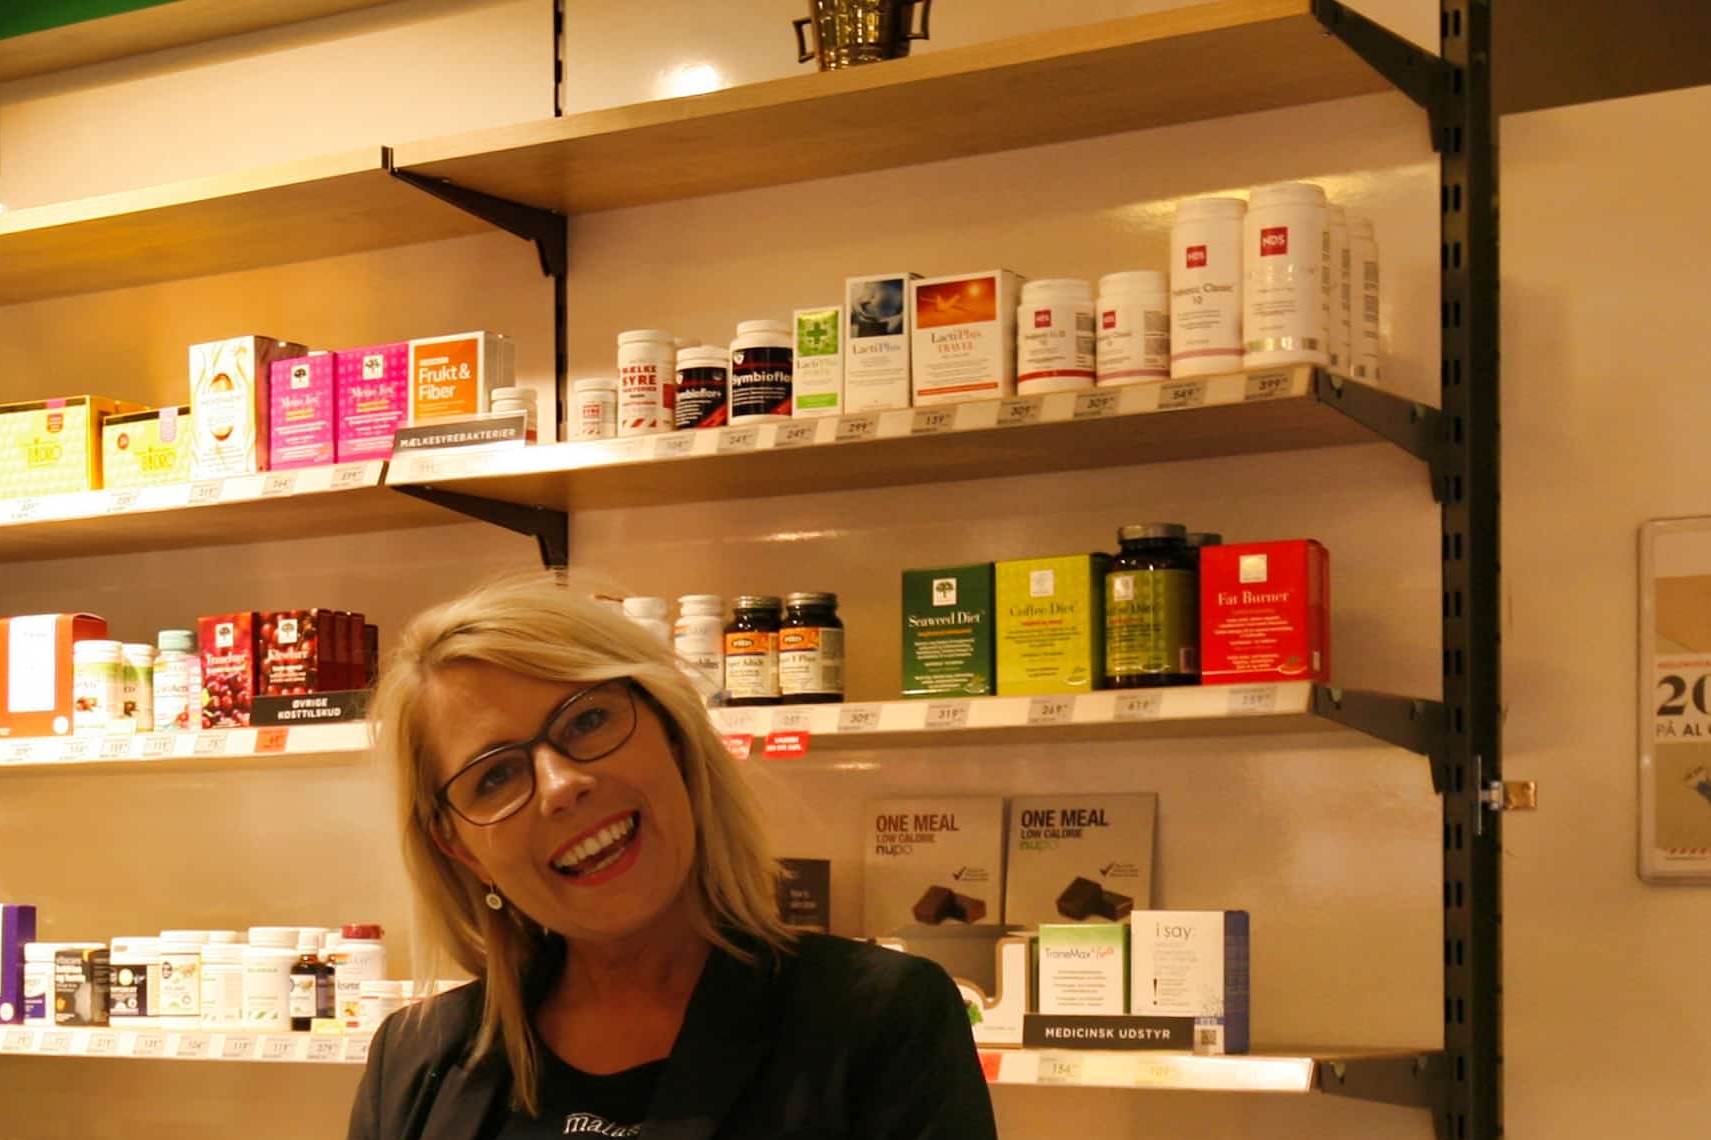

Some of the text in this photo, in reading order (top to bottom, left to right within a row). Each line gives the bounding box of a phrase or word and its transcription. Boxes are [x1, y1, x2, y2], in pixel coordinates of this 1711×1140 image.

[419, 364, 471, 382] Frukt &
[419, 384, 455, 400] Fiber
[400, 429, 516, 447] MÆLKESYREBAKTERIER
[876, 814, 959, 832] ONE MEAL
[1021, 809, 1109, 827] ONE MEAL
[1045, 1027, 1170, 1040] MEDICINSK UDSTYR
